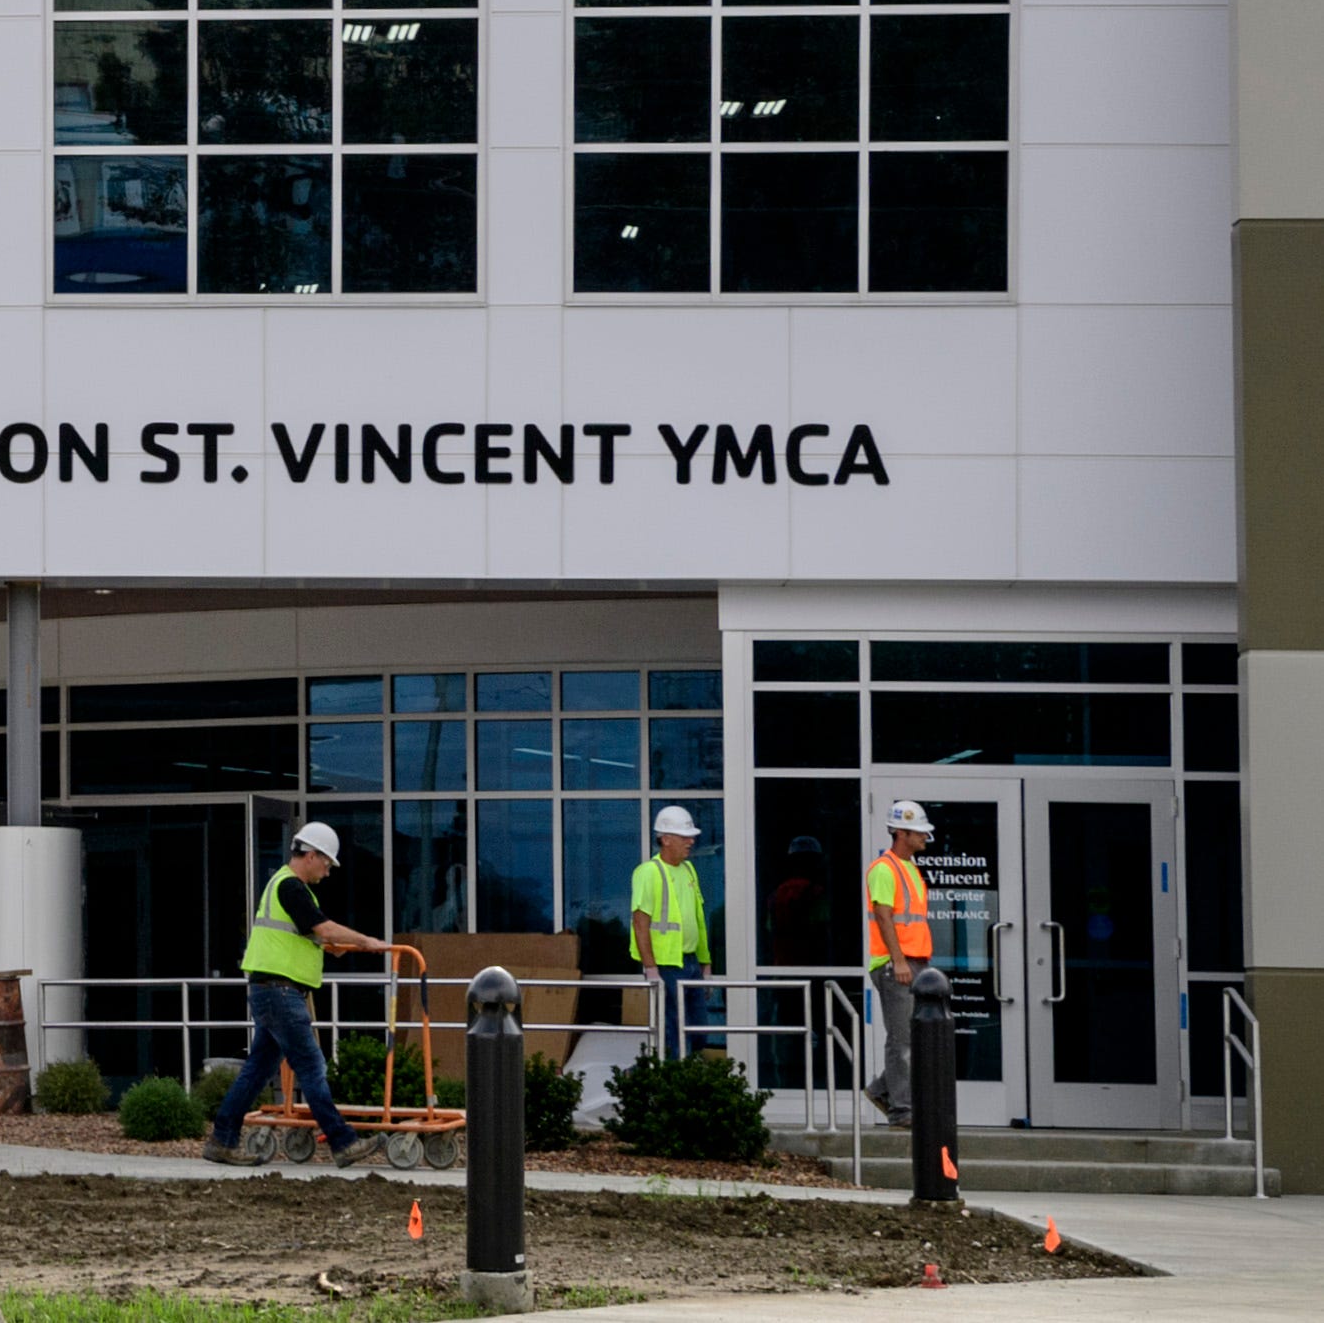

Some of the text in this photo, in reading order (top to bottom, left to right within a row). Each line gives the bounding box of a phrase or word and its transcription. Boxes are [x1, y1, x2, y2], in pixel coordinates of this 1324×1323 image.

[140, 422, 249, 484] ST.
[270, 422, 632, 484] VINCENT
[657, 423, 890, 486] YMCA
[926, 870, 991, 885] Vincent
[946, 890, 985, 901] Center
[937, 910, 990, 920] ENTRANCE
